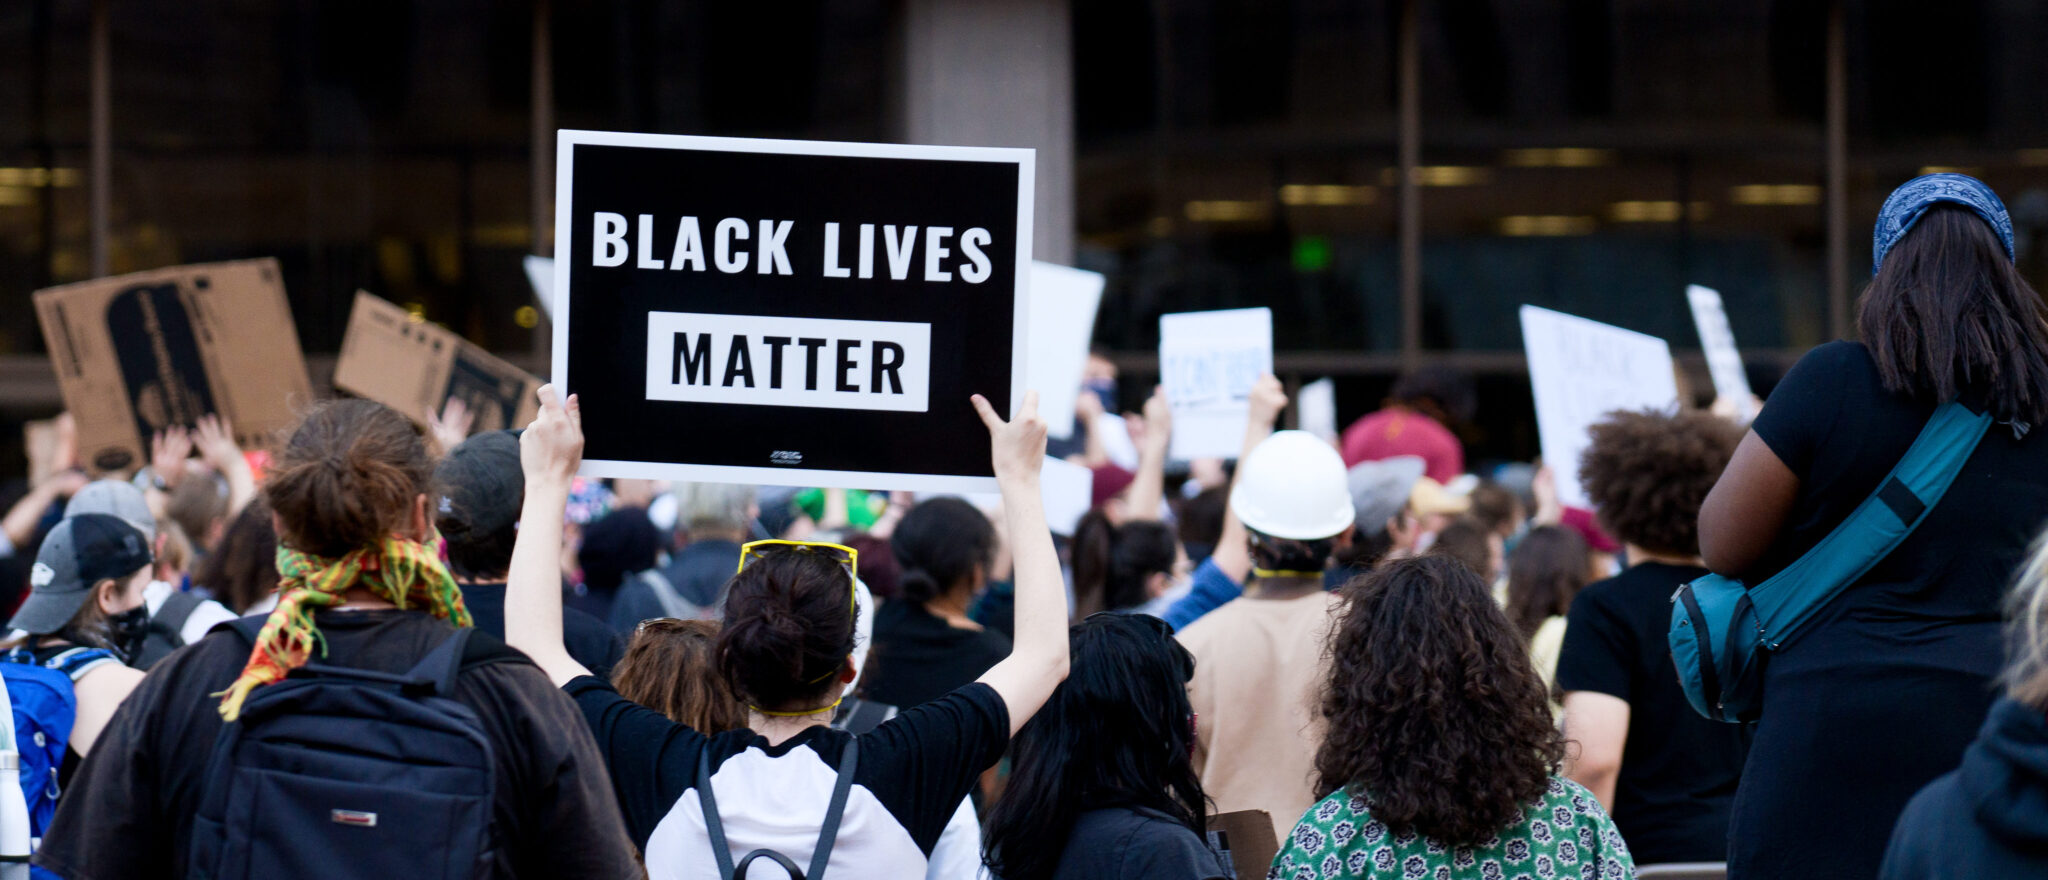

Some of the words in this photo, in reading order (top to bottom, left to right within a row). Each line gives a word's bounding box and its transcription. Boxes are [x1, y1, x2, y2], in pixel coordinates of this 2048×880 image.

[593, 212, 794, 275] BLACK
[824, 223, 991, 283] LIVES
[672, 332, 904, 394] MATTER
